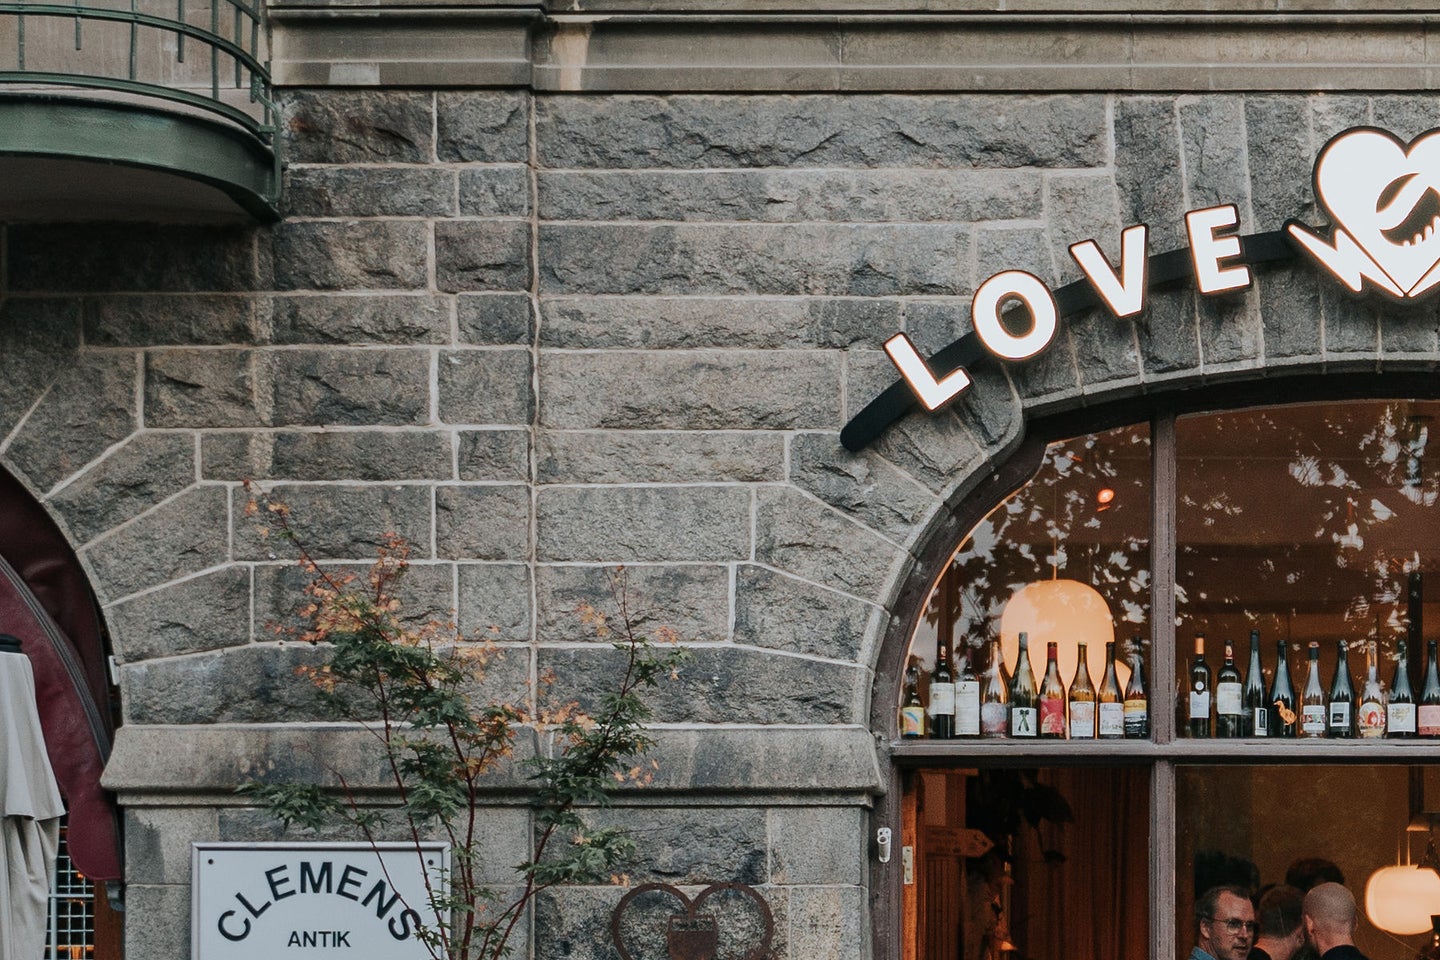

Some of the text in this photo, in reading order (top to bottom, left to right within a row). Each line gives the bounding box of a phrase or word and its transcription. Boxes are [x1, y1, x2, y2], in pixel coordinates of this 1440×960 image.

[882, 203, 1251, 411] LOVE
[217, 861, 422, 942] CLEMENS
[287, 930, 352, 948] ANTIK
